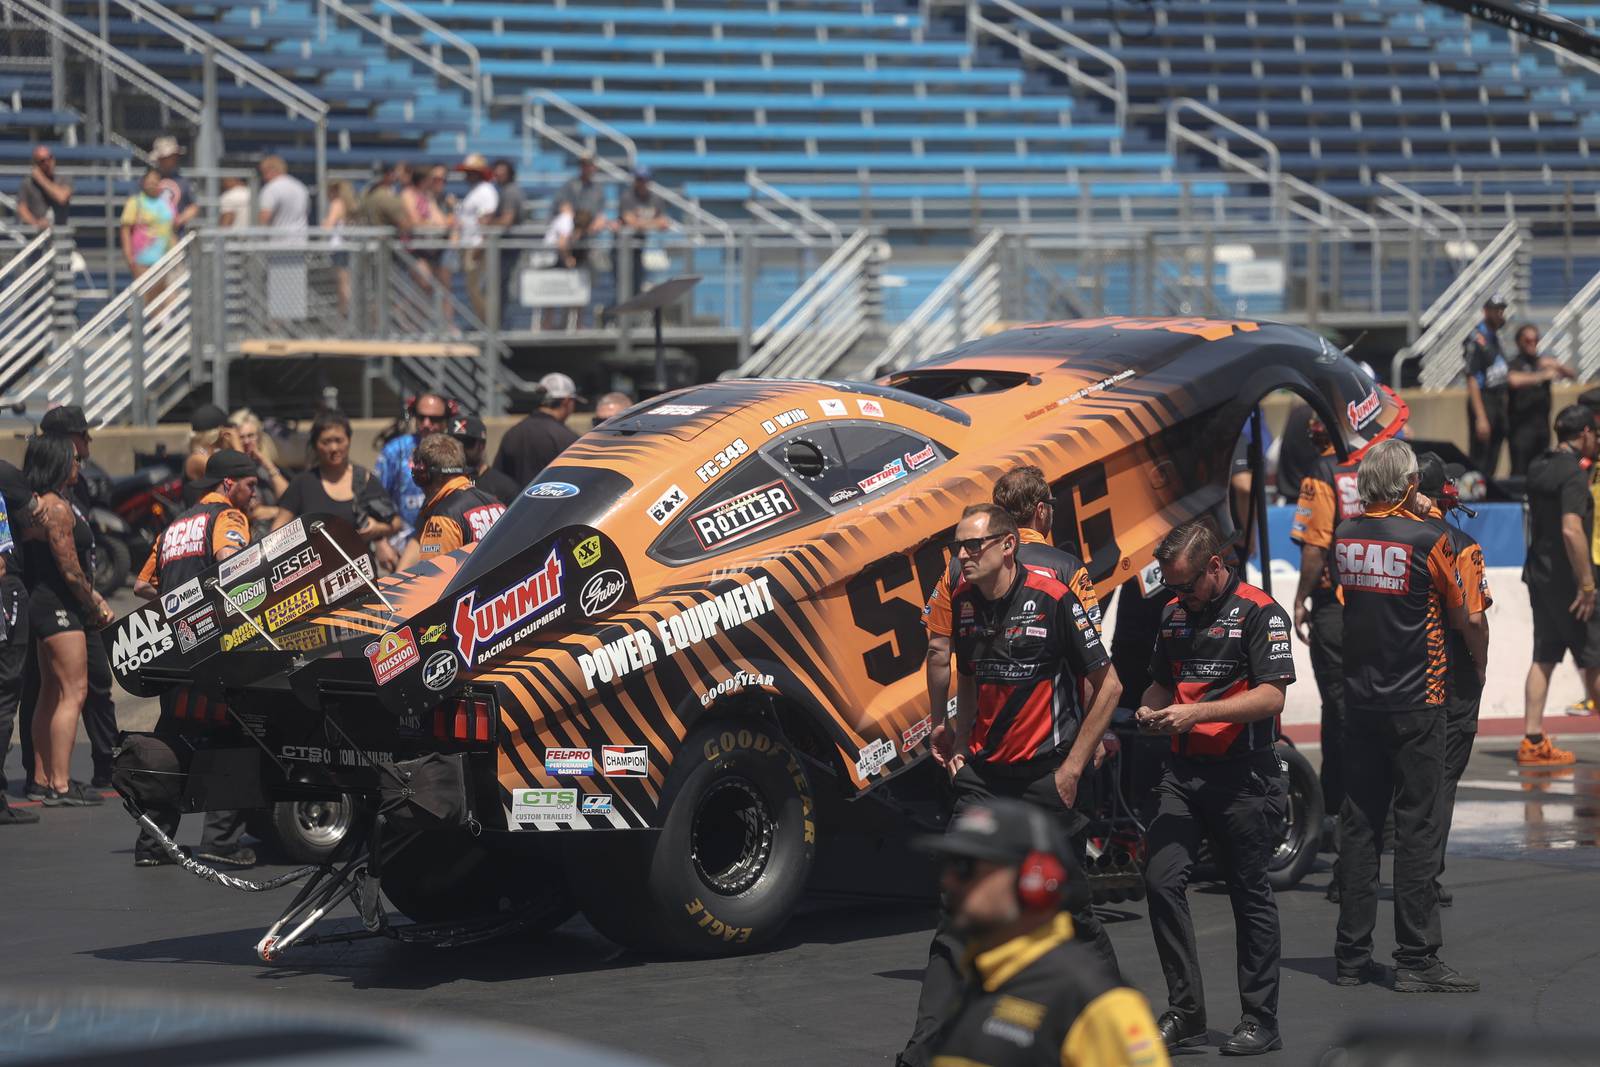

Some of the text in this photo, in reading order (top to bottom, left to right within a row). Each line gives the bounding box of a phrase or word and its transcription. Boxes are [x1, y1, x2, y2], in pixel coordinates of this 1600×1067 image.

[760, 419, 777, 435] D
[695, 437, 750, 484] FC 348
[904, 444, 936, 470] SUMMIT
[532, 482, 570, 496] Ford
[859, 464, 902, 489] VICTORY
[696, 488, 793, 544] ROTTLER
[270, 546, 320, 584] JESEL
[577, 541, 599, 561] AXE
[1336, 543, 1407, 577] SCAG
[179, 586, 200, 602] Miller
[225, 579, 266, 613] GOODSON
[269, 586, 314, 623] BULLET
[453, 547, 562, 669] SUMMIT
[583, 575, 626, 617] Gates
[275, 601, 315, 627] RACING CAMS
[112, 609, 173, 667] MAC
[420, 623, 447, 645] SUNOCO
[477, 603, 567, 665] RACING EQUIPMENT
[577, 576, 775, 691] POWER EQUIPMENT
[116, 636, 174, 676] TOOLS
[426, 655, 453, 684] LAT
[700, 670, 775, 707] GOODYEAR
[546, 751, 591, 760] FEL-PRO
[606, 755, 646, 767] CHAMPION
[522, 791, 575, 804] CTS
[515, 813, 573, 821] CUSTOM TRAILERS
[684, 897, 752, 944] EAGLE
